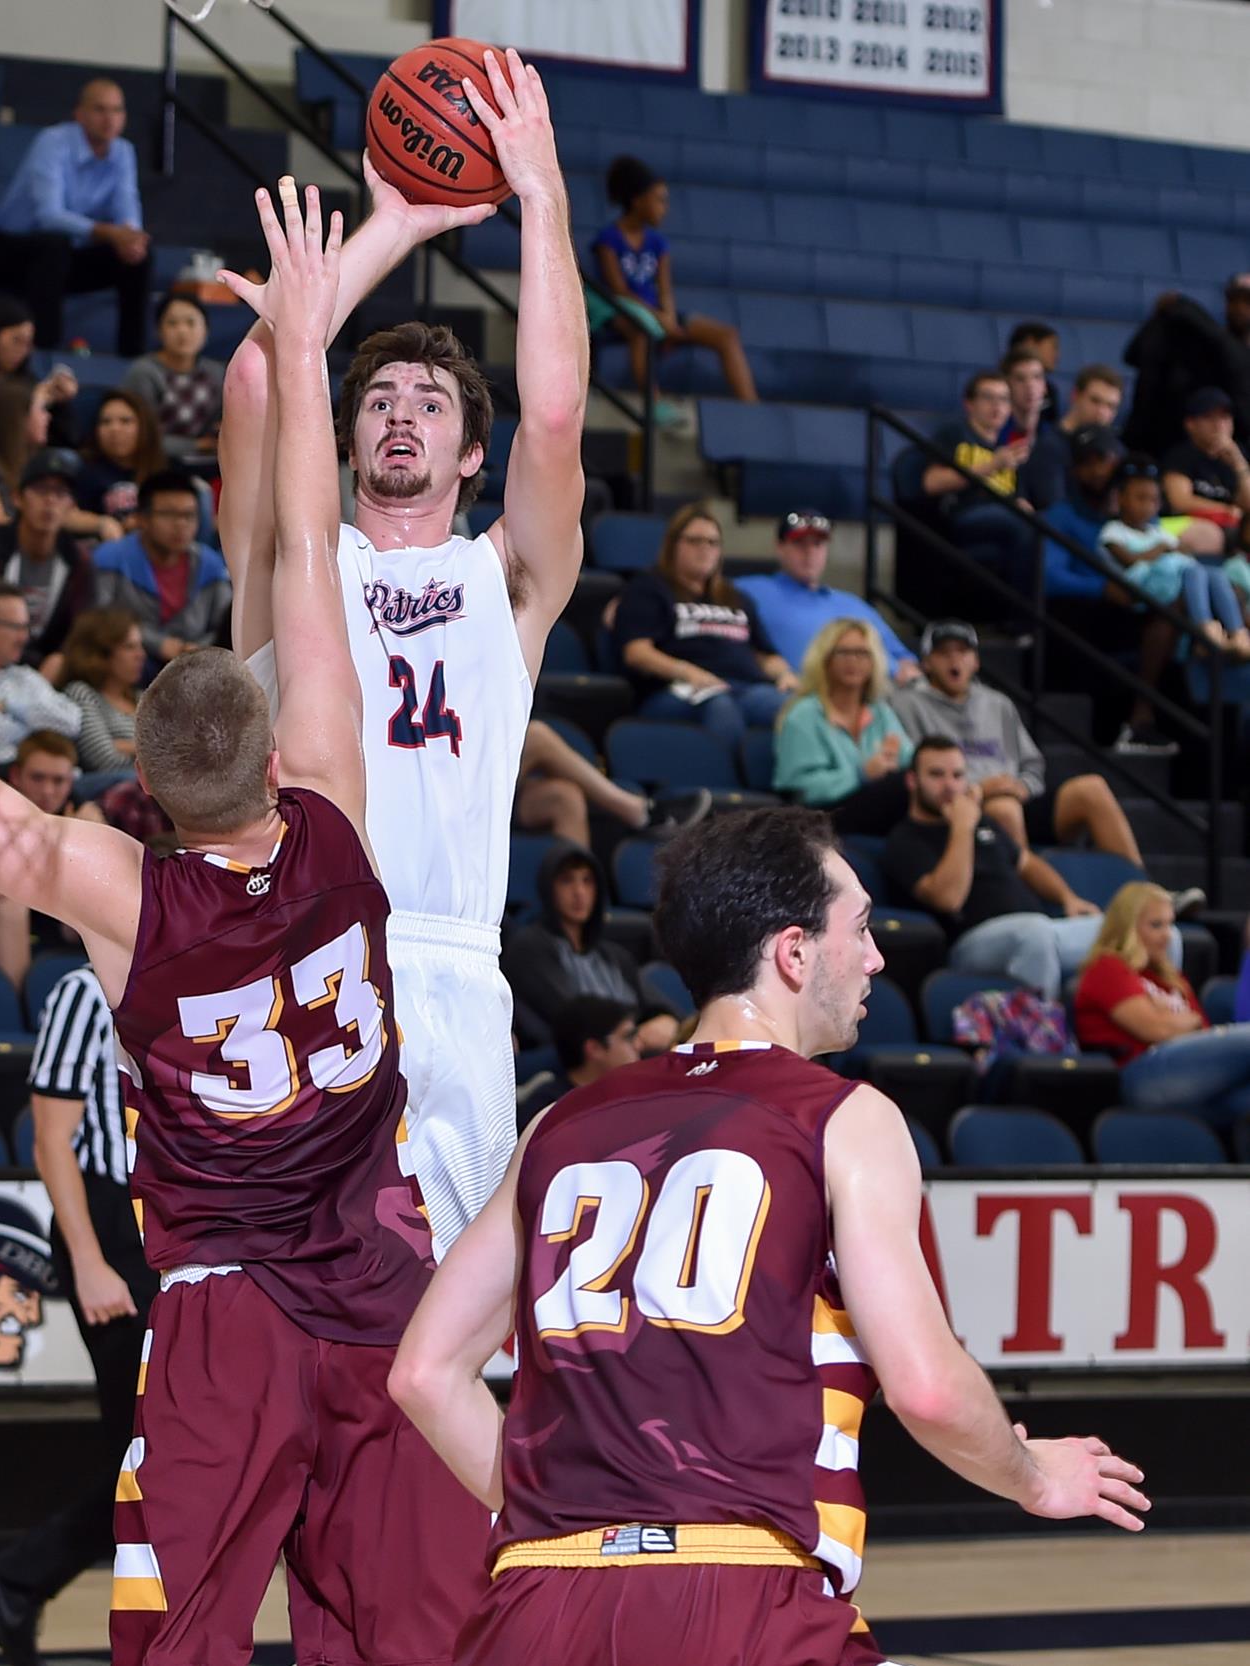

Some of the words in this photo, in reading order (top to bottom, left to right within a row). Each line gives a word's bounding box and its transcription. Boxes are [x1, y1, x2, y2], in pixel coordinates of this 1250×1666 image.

[778, 33, 839, 63] 2013
[852, 41, 907, 70] 2014
[926, 47, 981, 76] 2015
[853, 0, 907, 27] 2011
[925, 4, 981, 33] 2012
[379, 91, 465, 180] Wilson
[388, 655, 462, 758] 24
[177, 921, 387, 1119] 33
[534, 1149, 771, 1334] 20
